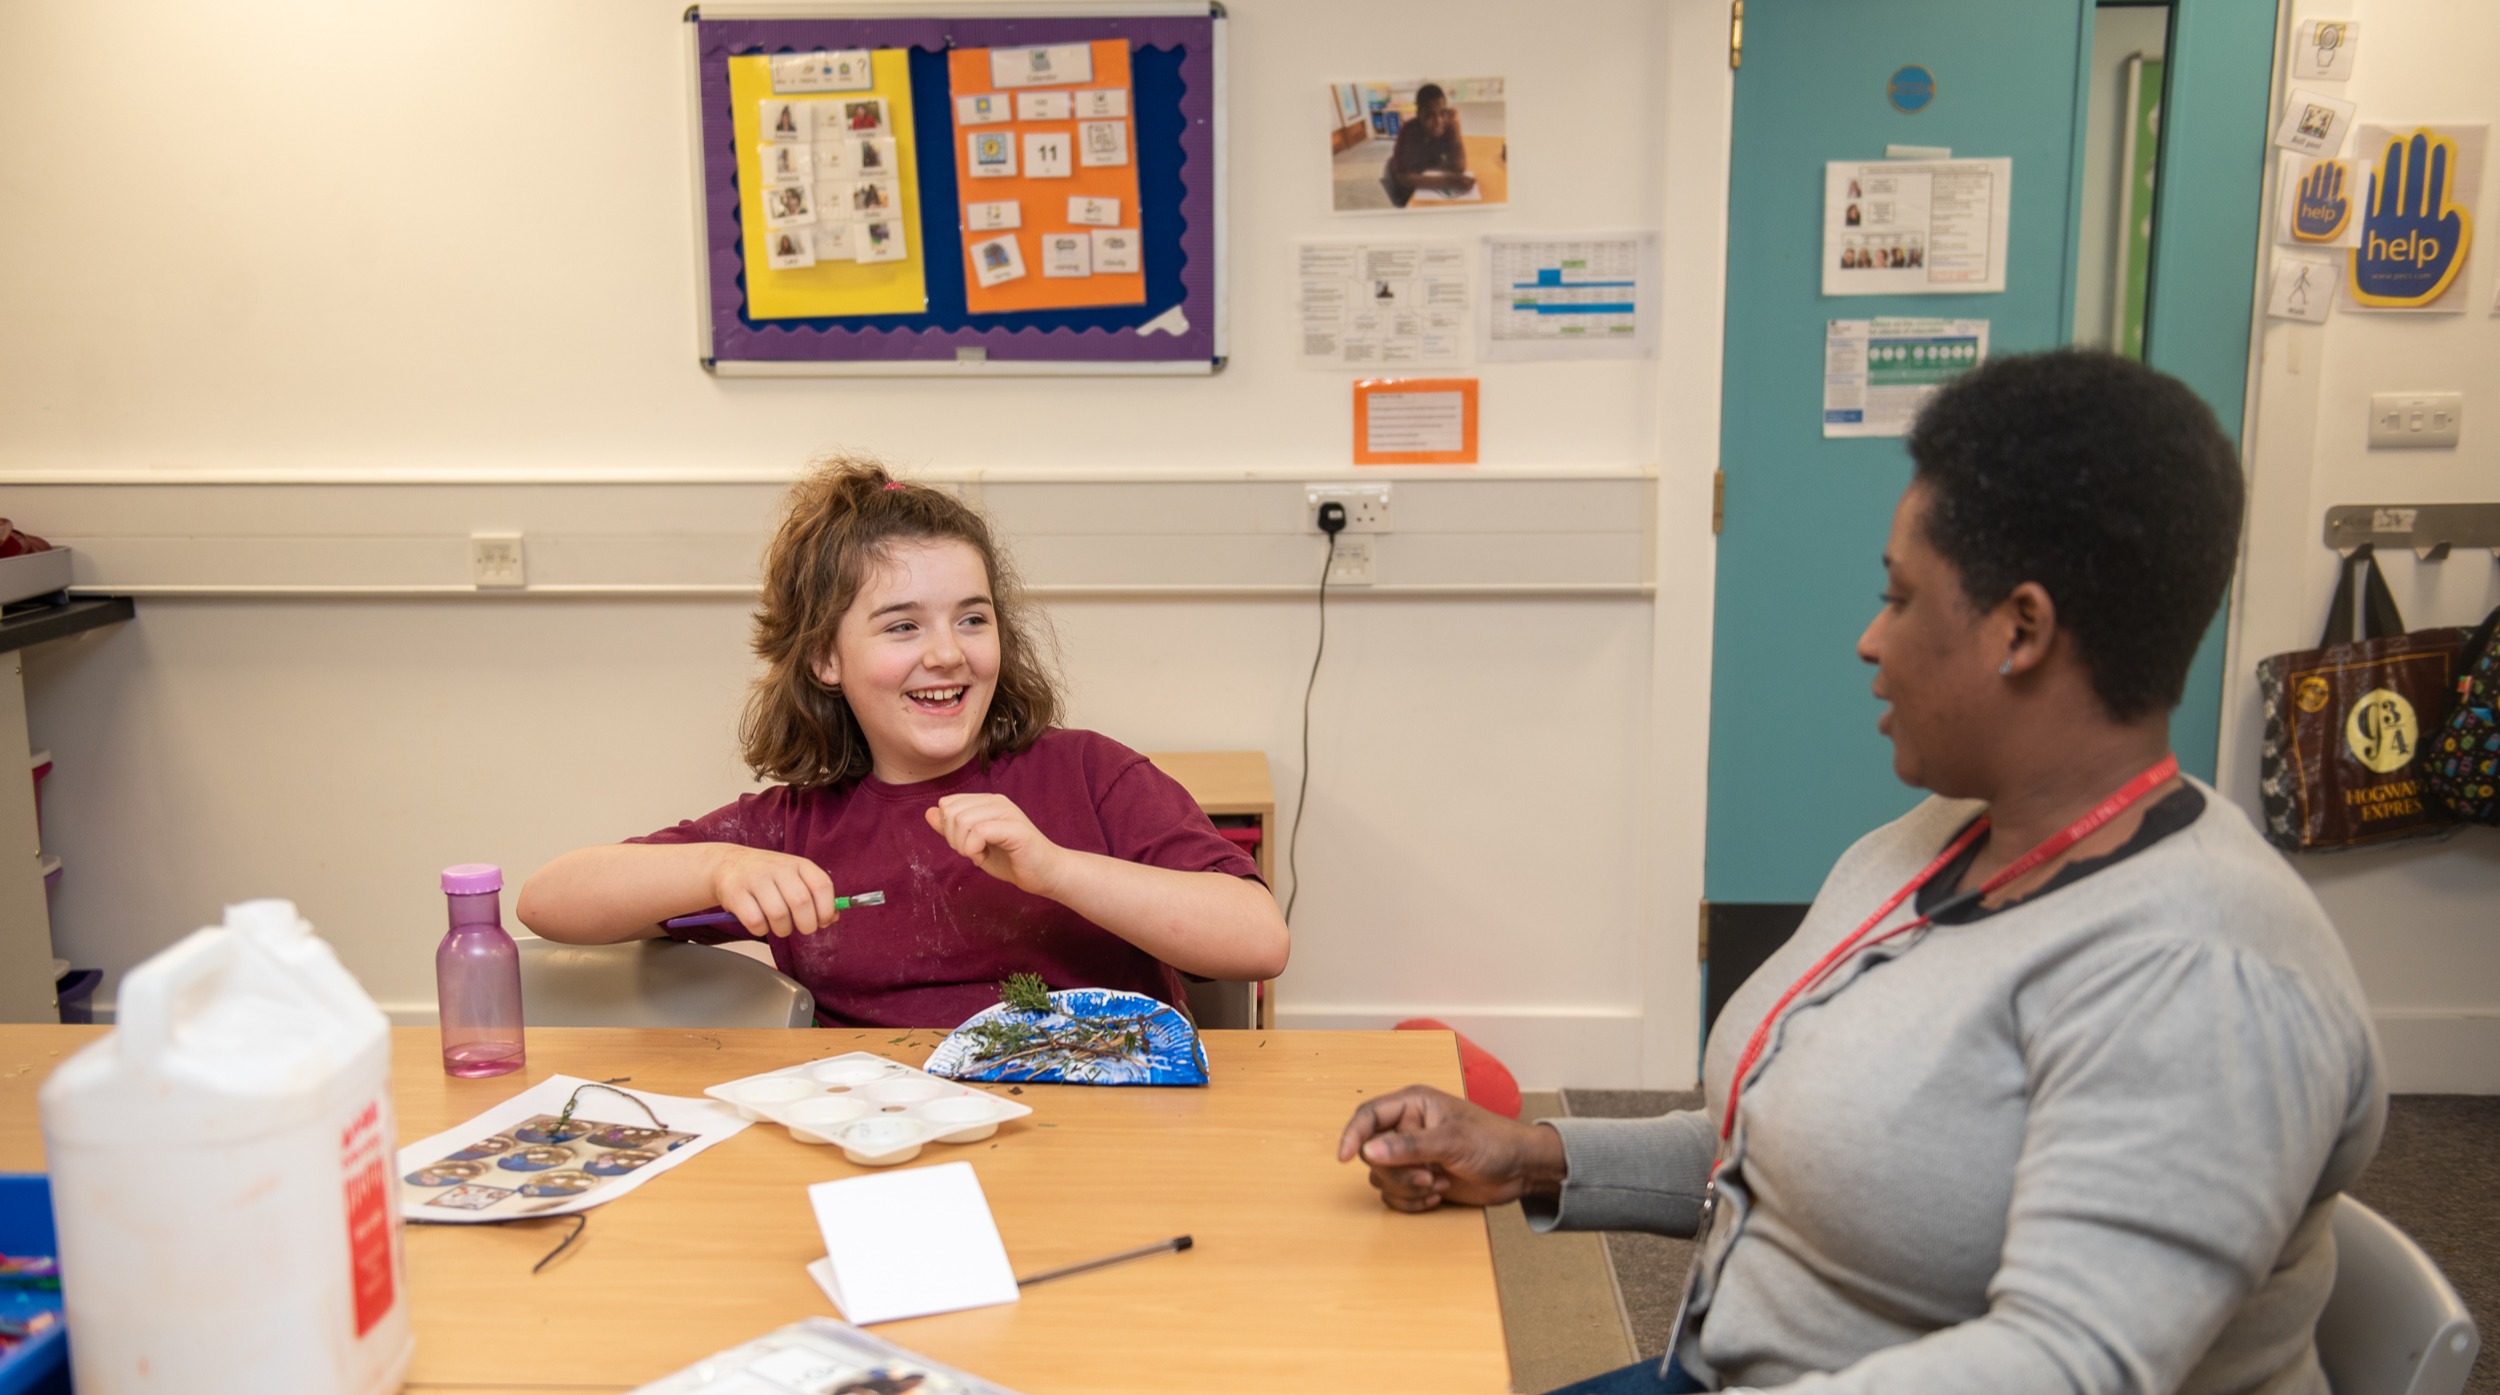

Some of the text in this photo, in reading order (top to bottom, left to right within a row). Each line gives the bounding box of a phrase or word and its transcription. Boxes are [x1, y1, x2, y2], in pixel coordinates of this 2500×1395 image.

[1038, 144, 1058, 161] 11
[2301, 203, 2336, 222] help
[2367, 229, 2440, 269] help
